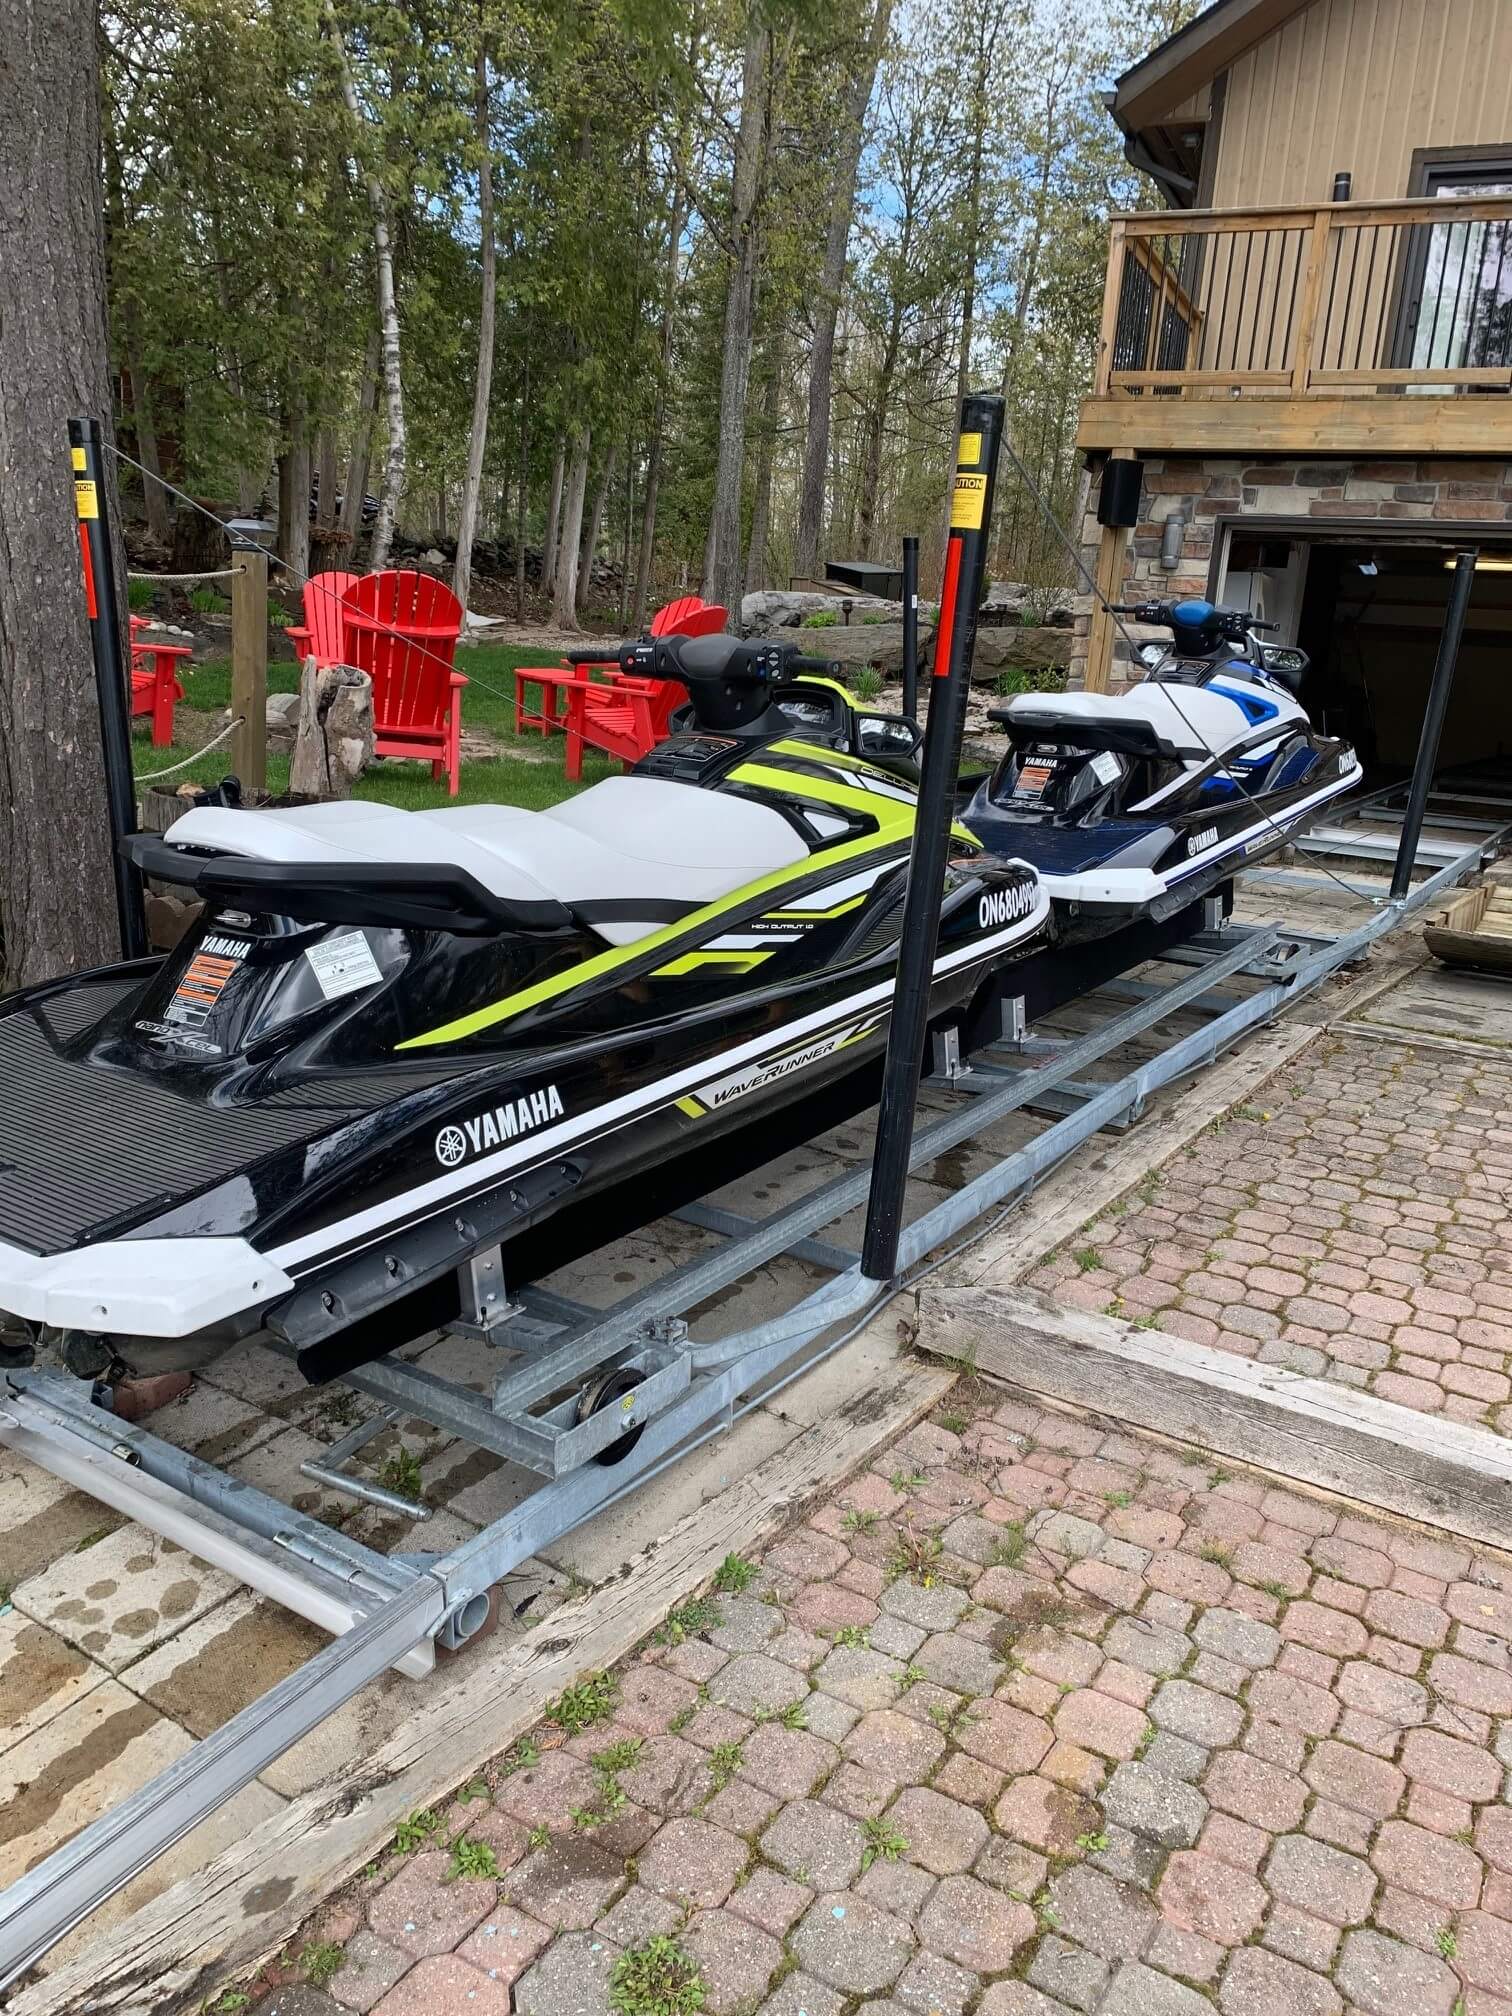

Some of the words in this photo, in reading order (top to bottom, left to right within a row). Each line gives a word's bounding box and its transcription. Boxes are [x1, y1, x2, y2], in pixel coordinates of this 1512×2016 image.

[1024, 756, 1058, 768] YAMAHA
[1194, 826, 1219, 853] YAMAHA
[199, 935, 252, 959] YAMAHA
[463, 1084, 565, 1153] YAMAHA
